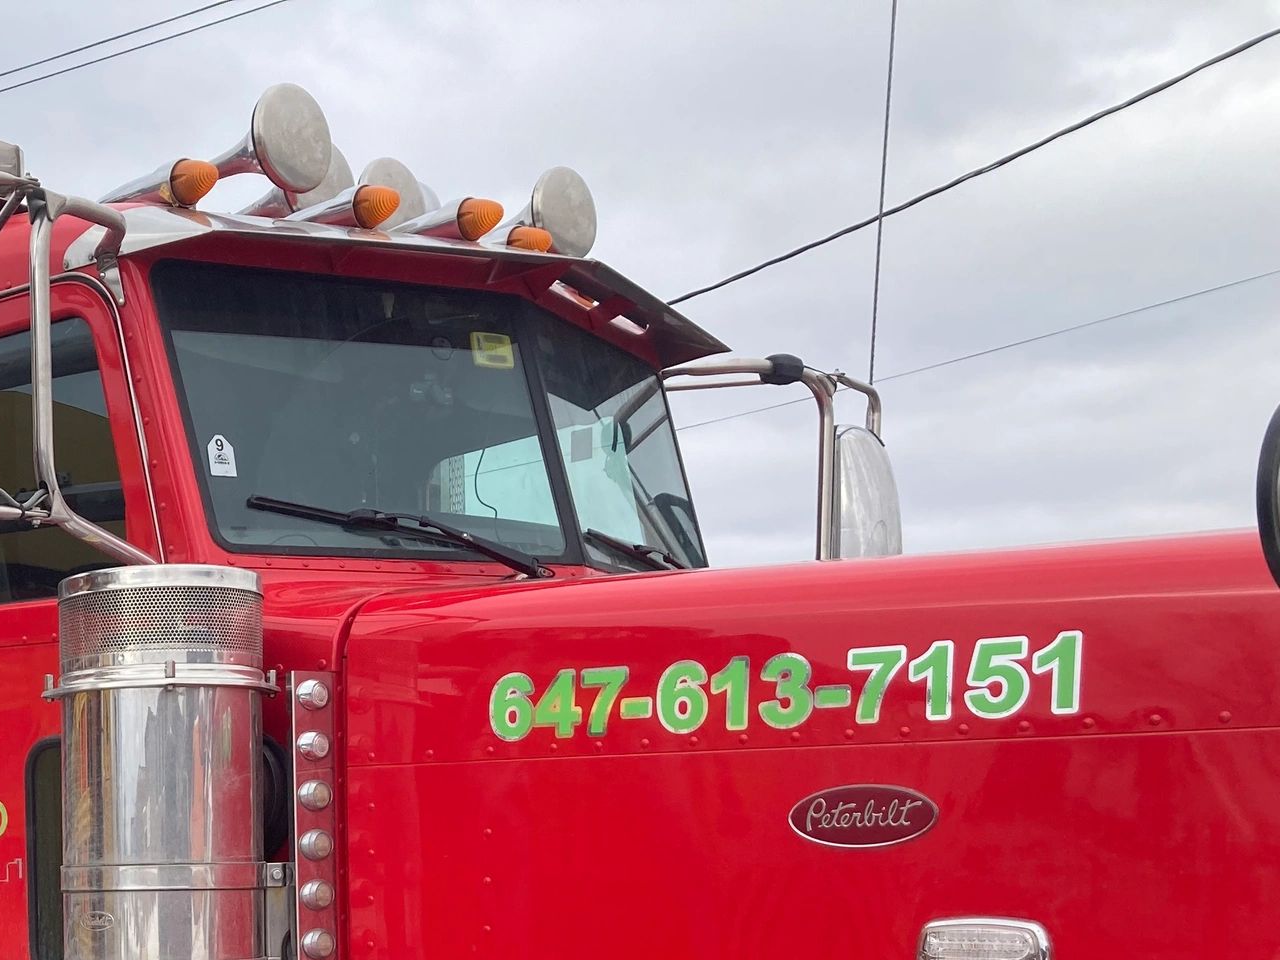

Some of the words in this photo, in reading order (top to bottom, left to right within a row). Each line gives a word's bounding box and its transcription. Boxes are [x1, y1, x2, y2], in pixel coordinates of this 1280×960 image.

[215, 438, 224, 451] 9
[488, 630, 1083, 741] 647-613-7151
[806, 798, 923, 832] Peterbilt
